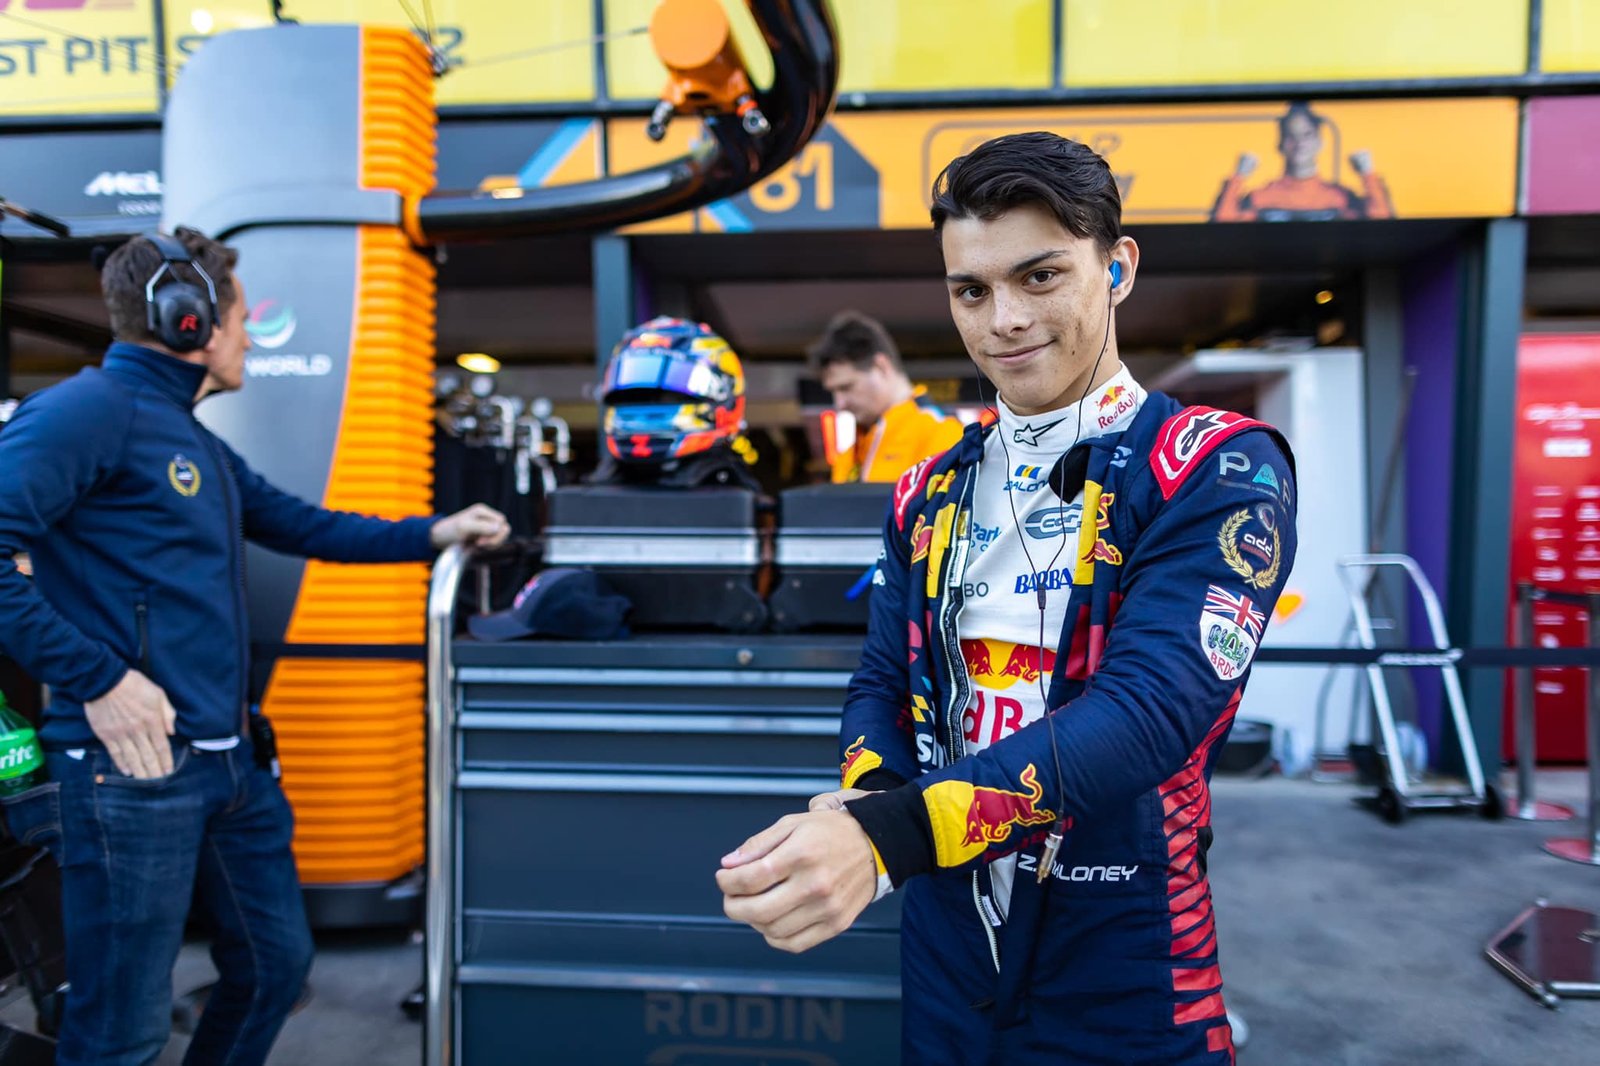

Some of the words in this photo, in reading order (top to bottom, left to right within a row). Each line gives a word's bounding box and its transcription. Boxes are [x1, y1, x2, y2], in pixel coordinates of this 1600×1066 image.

[63, 36, 148, 75] PIT
[1210, 651, 1235, 679] BRDC
[644, 991, 845, 1042] RODIN
